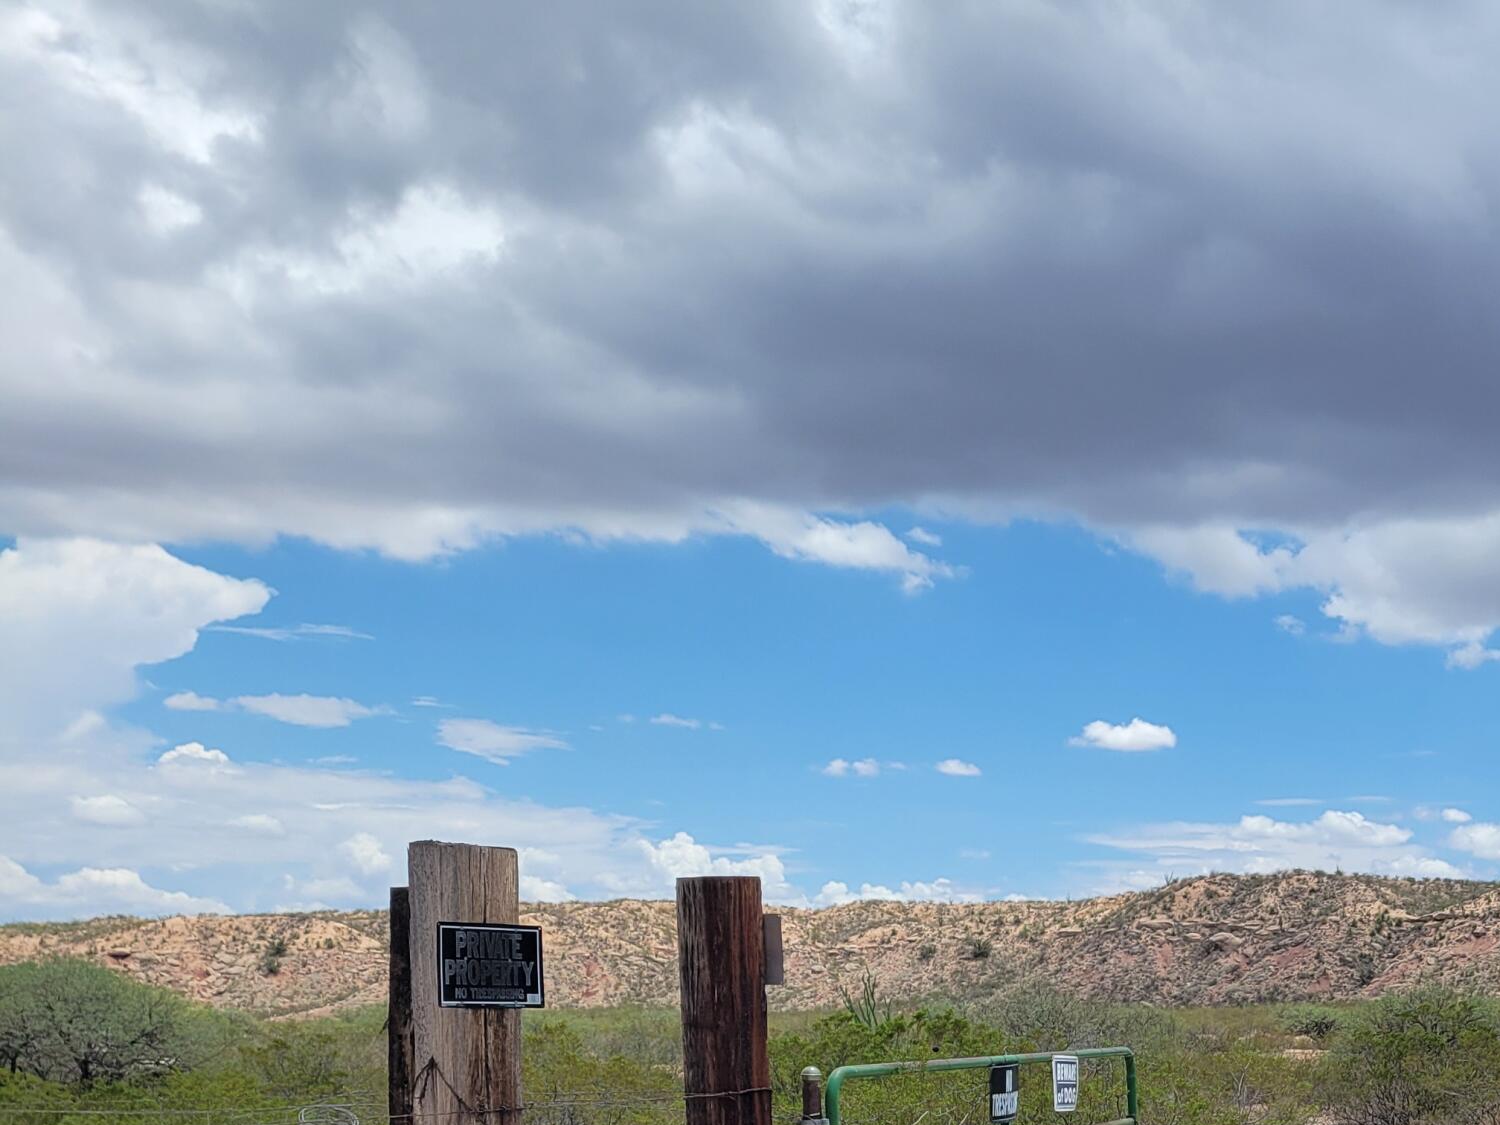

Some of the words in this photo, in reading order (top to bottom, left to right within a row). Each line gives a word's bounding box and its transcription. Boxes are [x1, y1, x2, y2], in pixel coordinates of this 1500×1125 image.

[455, 931, 523, 960] PRIVATE
[444, 958, 535, 986] PROPERTY
[455, 987, 468, 999] NO
[1056, 1063, 1077, 1081] BEWARE
[1064, 1087, 1076, 1104] DOG
